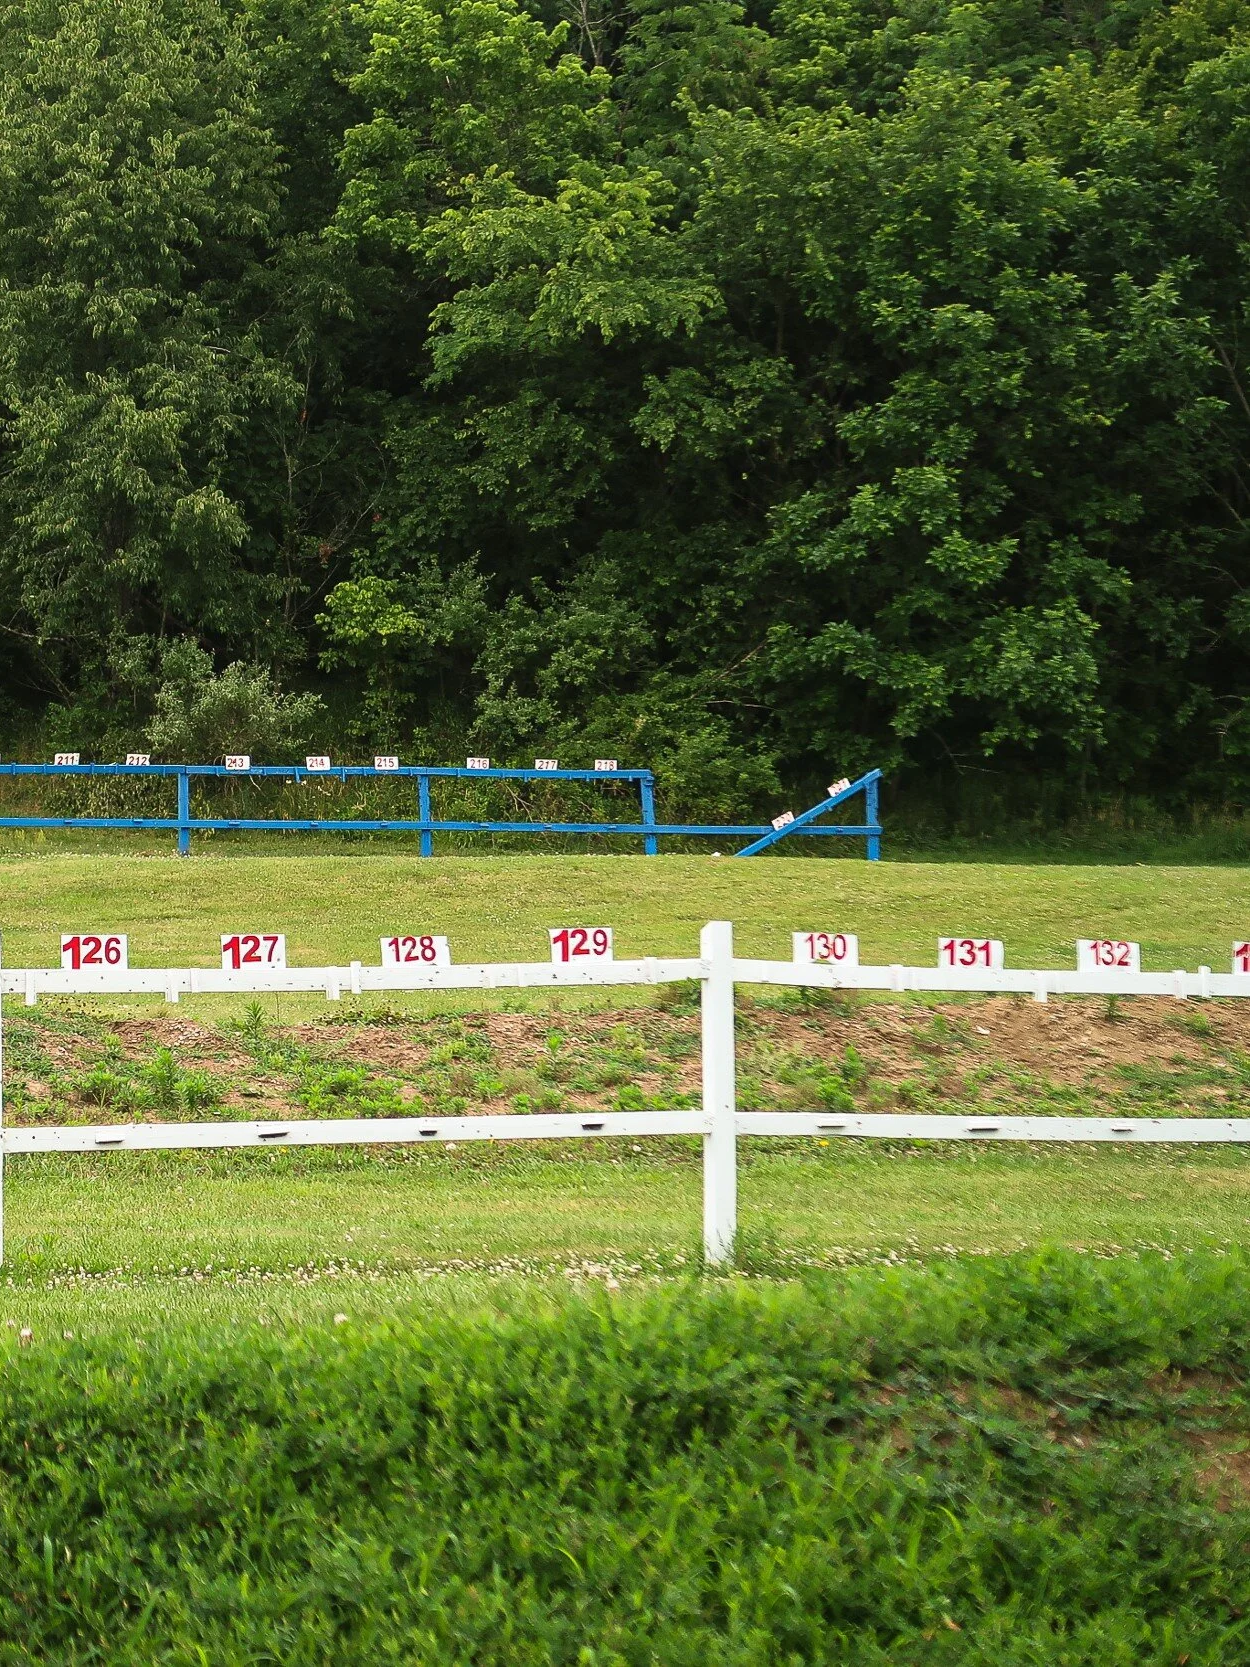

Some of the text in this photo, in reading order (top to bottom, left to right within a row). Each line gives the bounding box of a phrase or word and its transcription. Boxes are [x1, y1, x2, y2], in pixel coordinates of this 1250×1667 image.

[57, 754, 76, 766] 211
[128, 755, 148, 766] 212
[308, 757, 325, 768] 214
[376, 757, 395, 768] 215
[469, 758, 488, 769] 216
[538, 759, 557, 770] 217
[62, 936, 121, 970] 126
[222, 935, 279, 969] 127
[388, 935, 436, 962] 128
[552, 928, 609, 962] 129
[805, 932, 847, 960] 130
[943, 939, 993, 967] 131
[1089, 940, 1130, 966] 132
